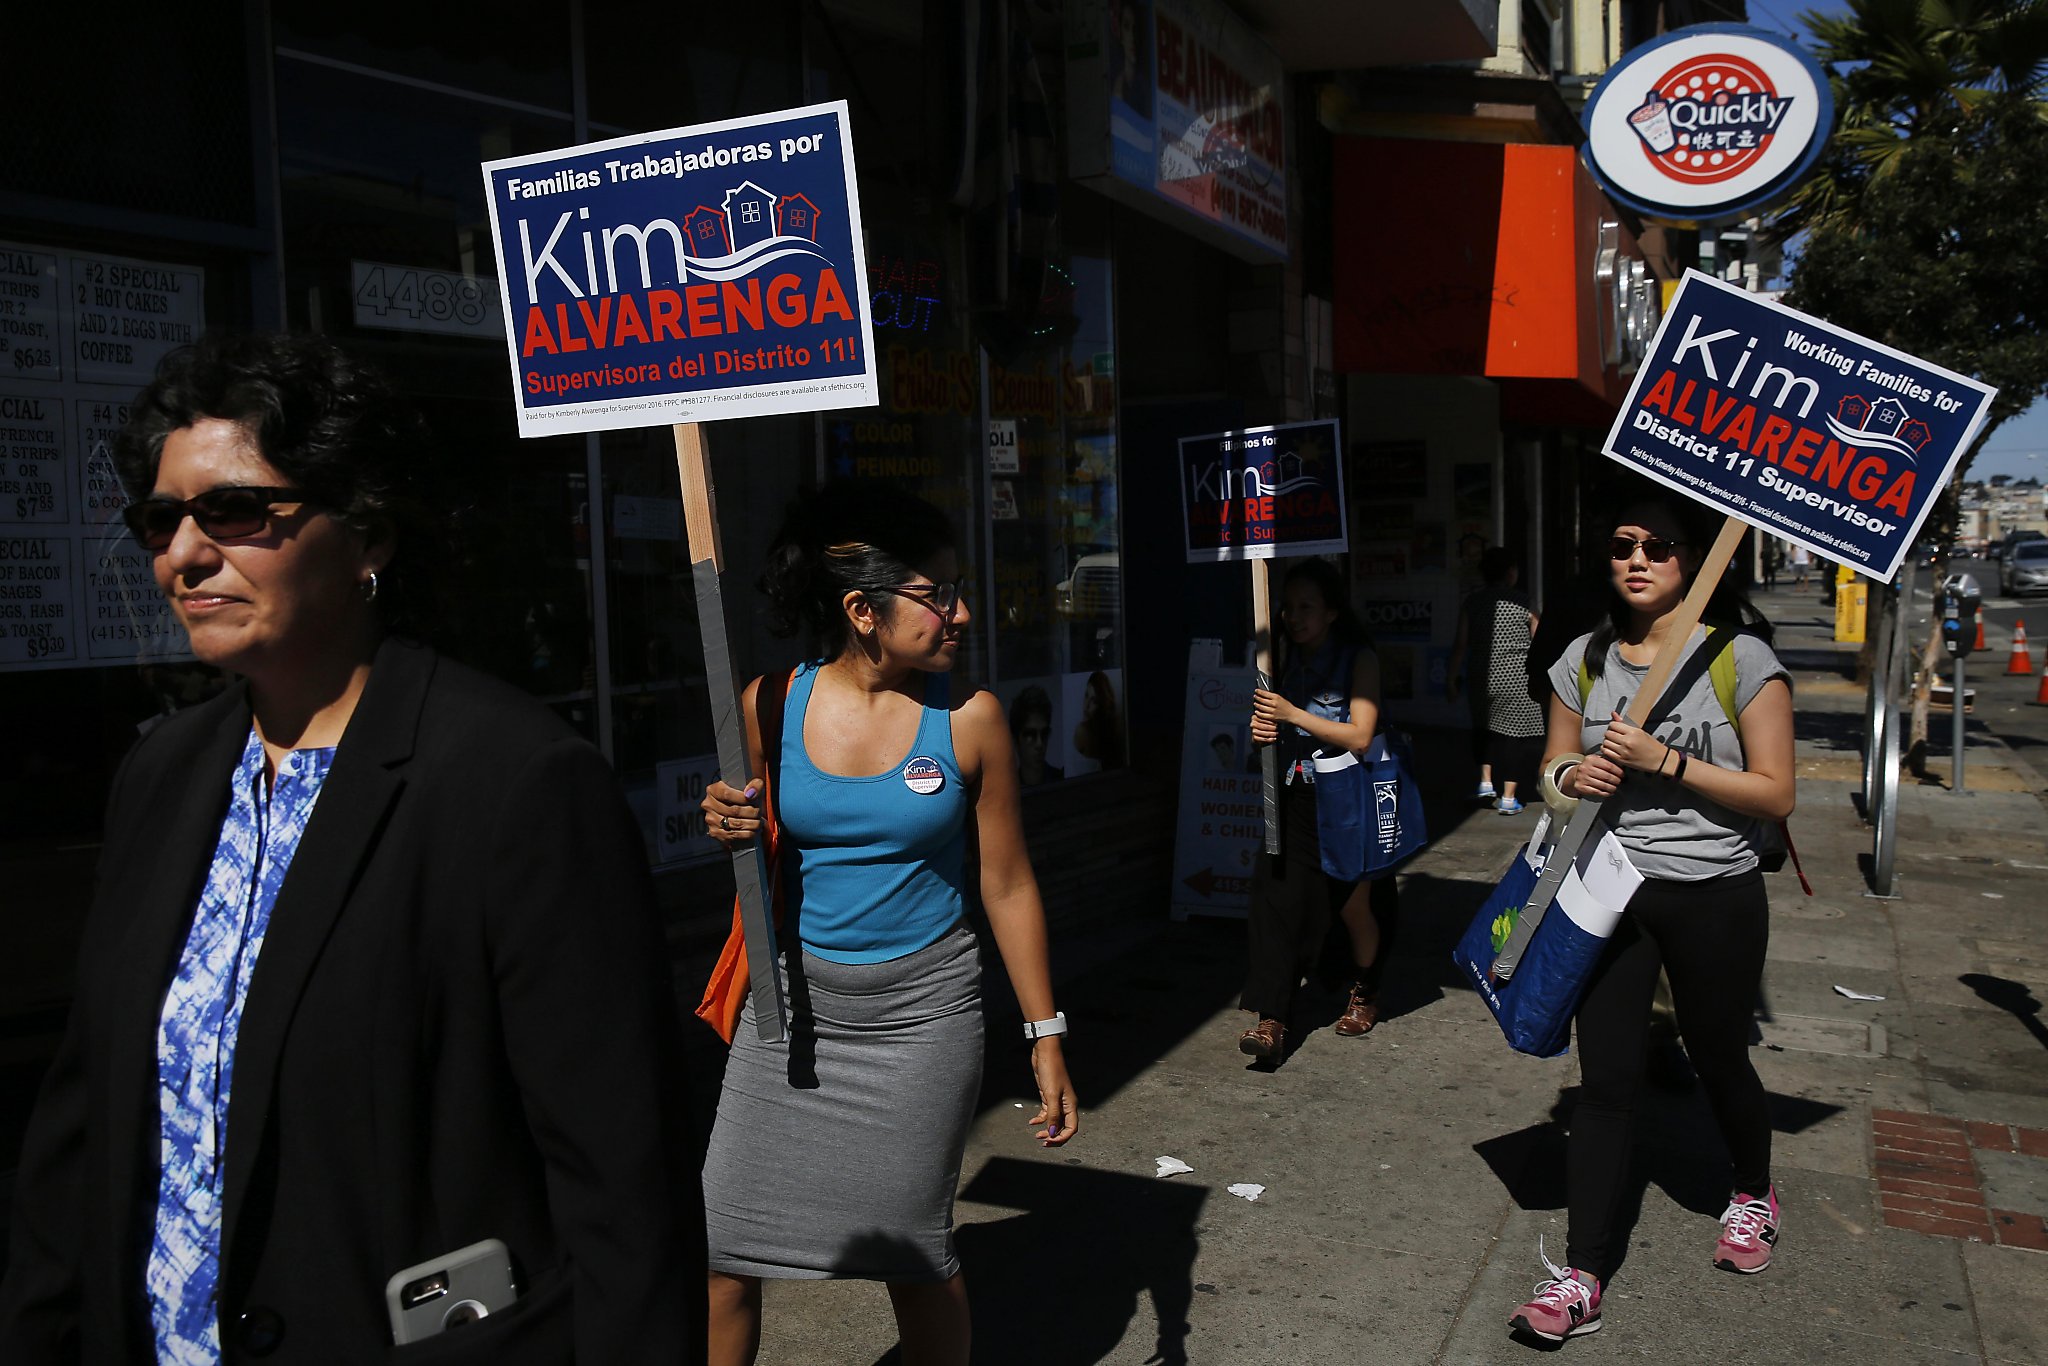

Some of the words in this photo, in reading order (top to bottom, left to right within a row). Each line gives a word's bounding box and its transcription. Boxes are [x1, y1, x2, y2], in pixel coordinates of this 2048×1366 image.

[1669, 95, 1785, 131] Quickly
[507, 167, 601, 200] Familias
[605, 141, 773, 183] Trabajadoras
[780, 132, 824, 162] por
[518, 206, 688, 304] Kim
[86, 263, 104, 284] #2
[110, 266, 180, 293] SPECIAL
[78, 284, 86, 304] 2
[95, 287, 122, 308] HOT
[125, 291, 168, 314] CAKES
[357, 266, 486, 325] 4488
[19, 302, 26, 315] 2
[522, 269, 854, 358] ALVARENGA
[870, 290, 943, 332] CUT
[80, 312, 107, 335] AND
[110, 316, 119, 336] 2
[122, 317, 156, 340] EGGS
[160, 322, 192, 344] WITH
[80, 340, 134, 365] COFFEE
[526, 361, 662, 396] Supervisora
[668, 353, 705, 380] del
[714, 343, 811, 375] Distrito
[819, 336, 857, 363] 11!
[1671, 314, 1820, 419] Kim
[1783, 329, 1856, 376] Working
[1855, 361, 1932, 403] Families
[1936, 390, 1963, 414] for
[617, 402, 648, 413] Supervisor
[713, 392, 742, 403] Financial
[743, 390, 779, 400] disclosures
[791, 385, 820, 395] available
[93, 404, 111, 423] #4
[0, 428, 54, 443] FRENCH
[87, 427, 94, 441] 2
[854, 423, 913, 444] COLOR
[1219, 439, 1260, 452] Filipinos
[1262, 435, 1280, 447] for
[1641, 369, 1919, 519] ALVARENGA
[12, 446, 58, 461] STRIPS
[19, 464, 38, 477] OR
[1192, 459, 1262, 503] Kim
[1633, 409, 1719, 464] District
[1725, 451, 1755, 478] 11
[1757, 466, 1897, 538] Supervisor
[25, 481, 52, 495] AND
[1191, 491, 1337, 525] ALVARENGA
[1706, 482, 1734, 501] Supervisor
[1748, 501, 1773, 518] Financial
[1772, 511, 1803, 531] disclosures
[1801, 525, 1811, 535] are
[1809, 529, 1835, 545] available
[18, 565, 60, 580] BACON
[99, 556, 140, 569] OPEN
[0, 585, 42, 599] SAGES
[98, 590, 140, 602] FOOD
[30, 604, 64, 618] HASH
[98, 605, 155, 619] PLEASE
[1366, 602, 1431, 624] COOK
[11, 623, 53, 638] TOAST
[906, 765, 926, 775] Kim
[676, 773, 702, 802] NO
[1202, 777, 1237, 793] HAIR
[1242, 779, 1263, 794] CU
[1201, 802, 1265, 818] WOMEN
[1202, 823, 1213, 836] &
[1220, 824, 1264, 839] CHIL
